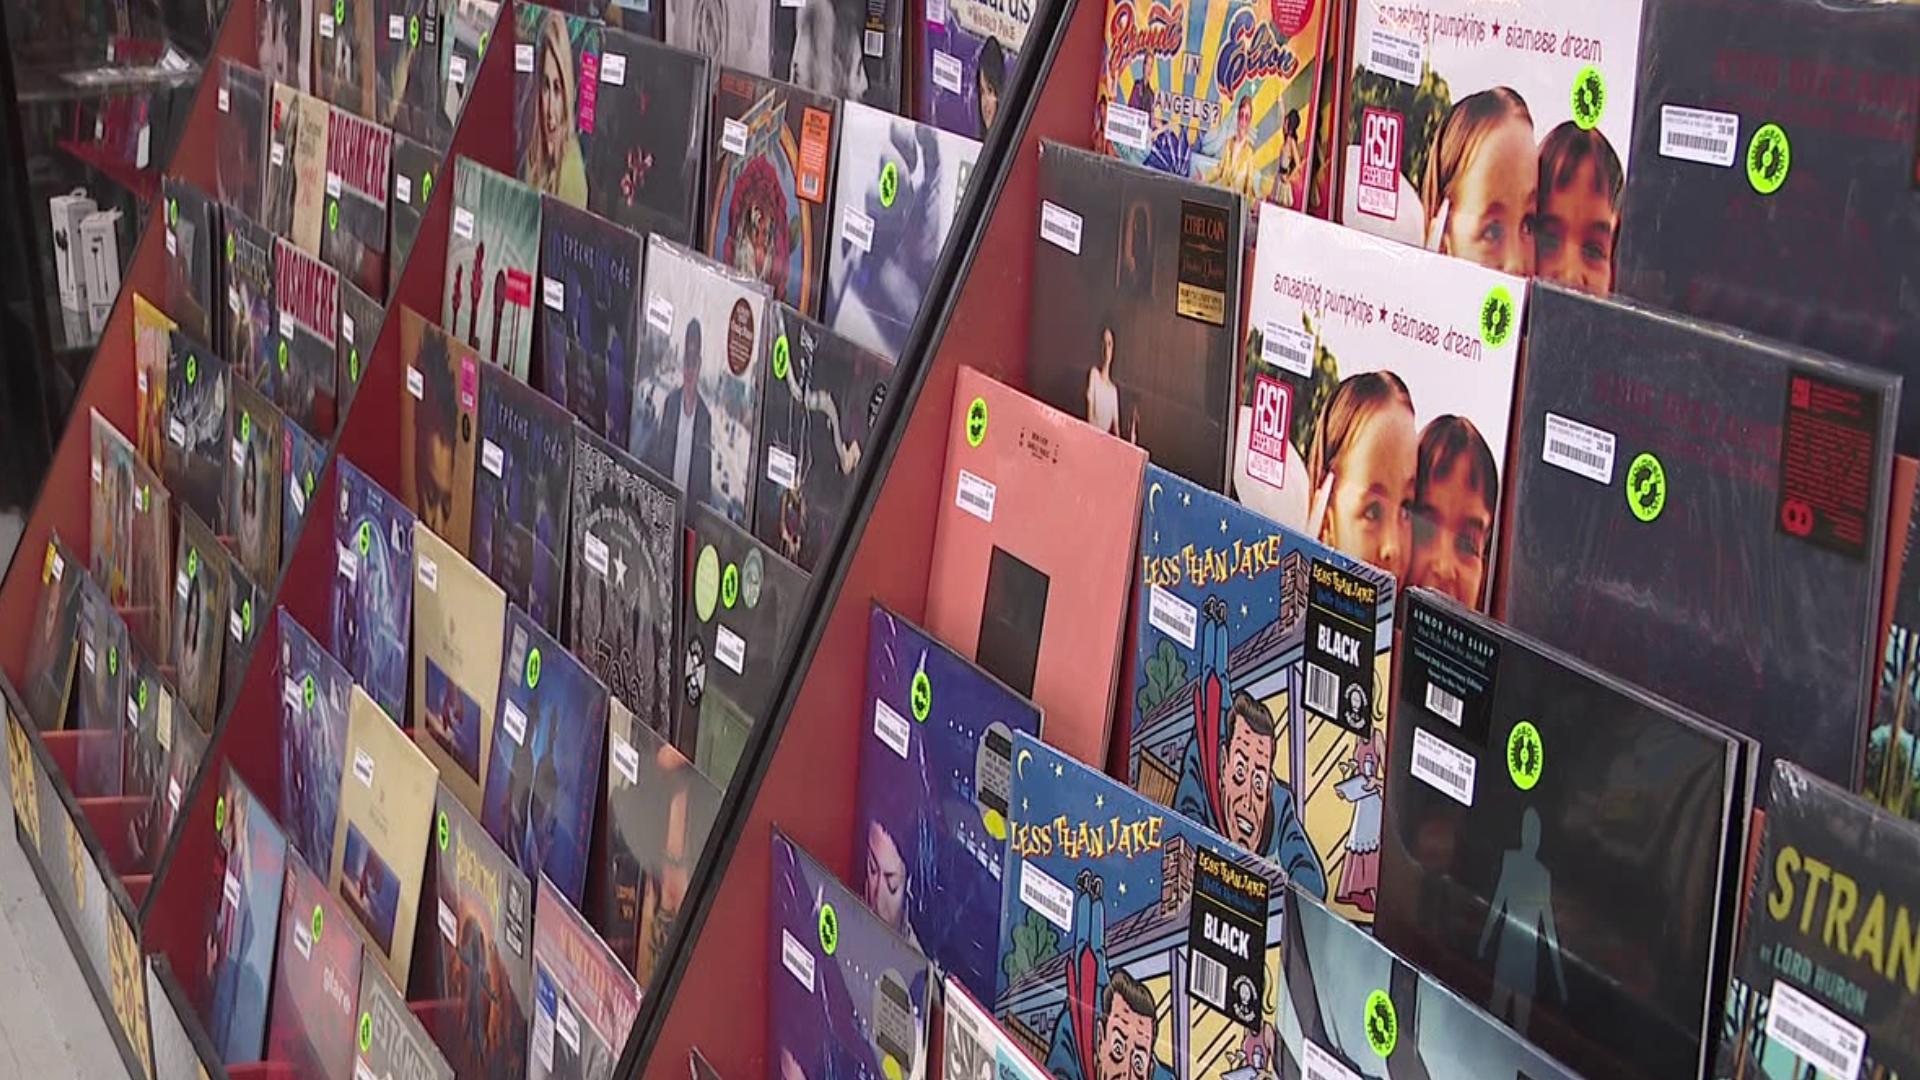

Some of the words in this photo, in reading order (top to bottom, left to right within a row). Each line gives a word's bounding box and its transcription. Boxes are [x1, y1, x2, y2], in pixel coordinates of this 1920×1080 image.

[1216, 6, 1299, 98] Elton
[1378, 5, 1430, 45] smashing
[1433, 13, 1486, 49] pumpkins
[1505, 19, 1555, 55] siamese
[1561, 29, 1603, 63] dream
[1183, 52, 1200, 77] IN
[1153, 91, 1222, 128] ANGELS?
[1364, 113, 1398, 171] RSD
[1273, 272, 1322, 317] smashing
[1324, 288, 1374, 329] pumpkins
[1391, 307, 1440, 346] siamese
[1442, 325, 1483, 362] dream
[1255, 381, 1288, 440] RSD
[1142, 553, 1182, 588] LESS
[1182, 543, 1228, 586] THAN
[1230, 534, 1283, 581] JAKE
[1312, 563, 1332, 587] LESS
[1331, 570, 1352, 596] THAN
[1351, 580, 1375, 604] JAKE
[1317, 623, 1361, 668] BLACK
[1009, 820, 1053, 859] LESS
[1053, 814, 1104, 859] THAN
[1106, 815, 1165, 859] JAKE
[1198, 852, 1220, 877] LESS
[1219, 860, 1242, 888] THAN
[1241, 871, 1267, 897] JAKE
[1203, 911, 1250, 960] BLACK
[1767, 846, 1920, 995] STRAN
[1773, 941, 1813, 984] LORD
[1813, 967, 1868, 1017] HURON
